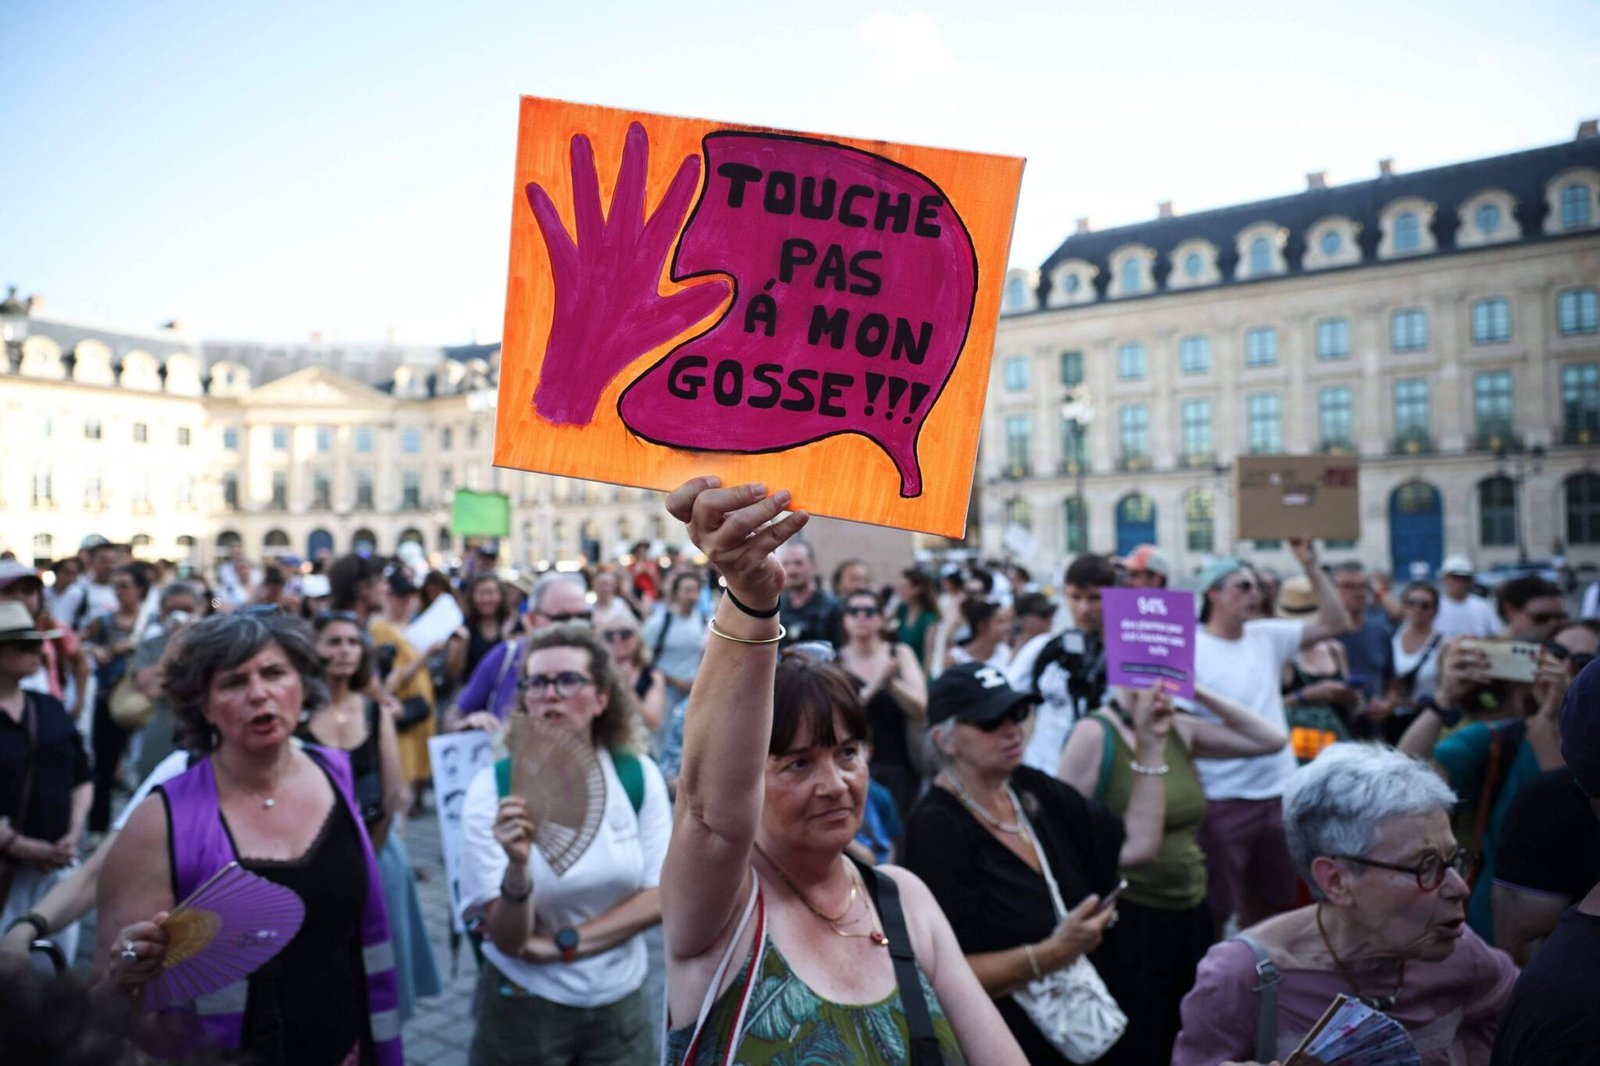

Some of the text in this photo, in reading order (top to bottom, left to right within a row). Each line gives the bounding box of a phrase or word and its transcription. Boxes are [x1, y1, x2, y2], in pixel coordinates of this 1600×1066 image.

[717, 162, 944, 238] TOUCHE
[779, 238, 883, 296] PAS
[807, 304, 933, 365] MON
